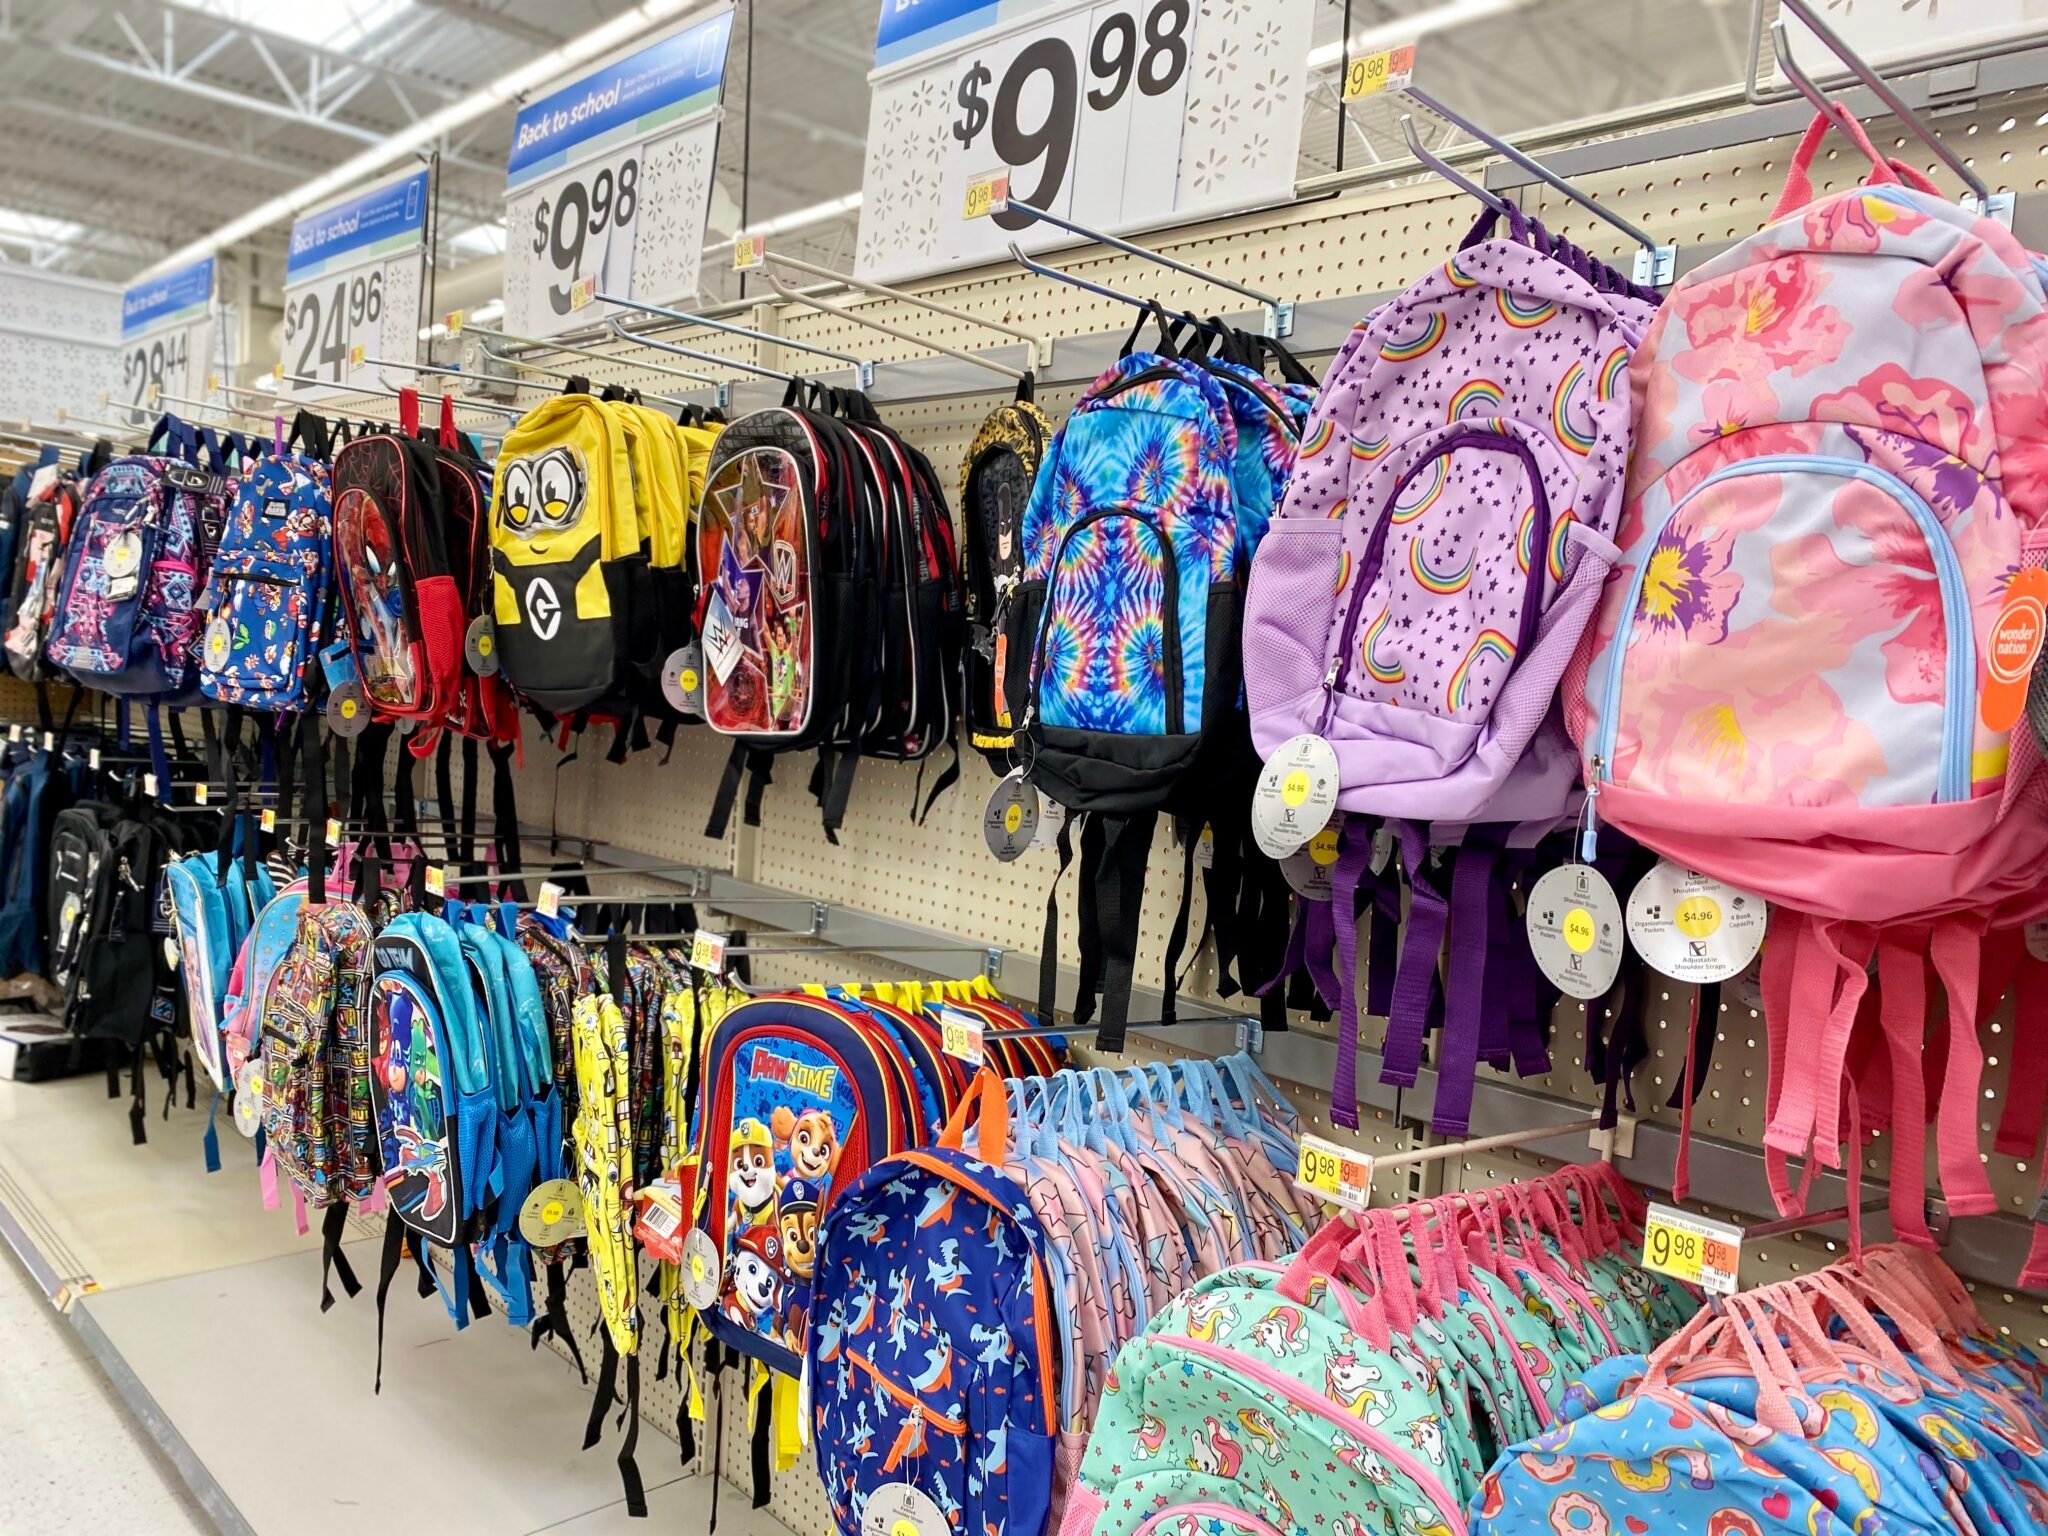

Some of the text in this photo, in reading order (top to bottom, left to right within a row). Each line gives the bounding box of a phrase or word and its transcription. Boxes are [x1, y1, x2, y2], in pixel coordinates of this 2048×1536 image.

[518, 113, 550, 150] Back
[552, 115, 568, 133] to
[570, 78, 622, 125] school
[328, 210, 360, 241] school
[2000, 622, 2034, 640] wonder
[1998, 641, 2027, 654] nation
[1287, 783, 1305, 793] $4.96
[1315, 842, 1336, 852] $4.96
[1702, 884, 1721, 892] Straps
[1683, 911, 1713, 922] $4.96
[1570, 923, 1590, 936] $4.96
[1729, 920, 1754, 928] Capacity
[385, 947, 414, 972] TEAM
[1649, 1214, 1677, 1226] AVENGERS
